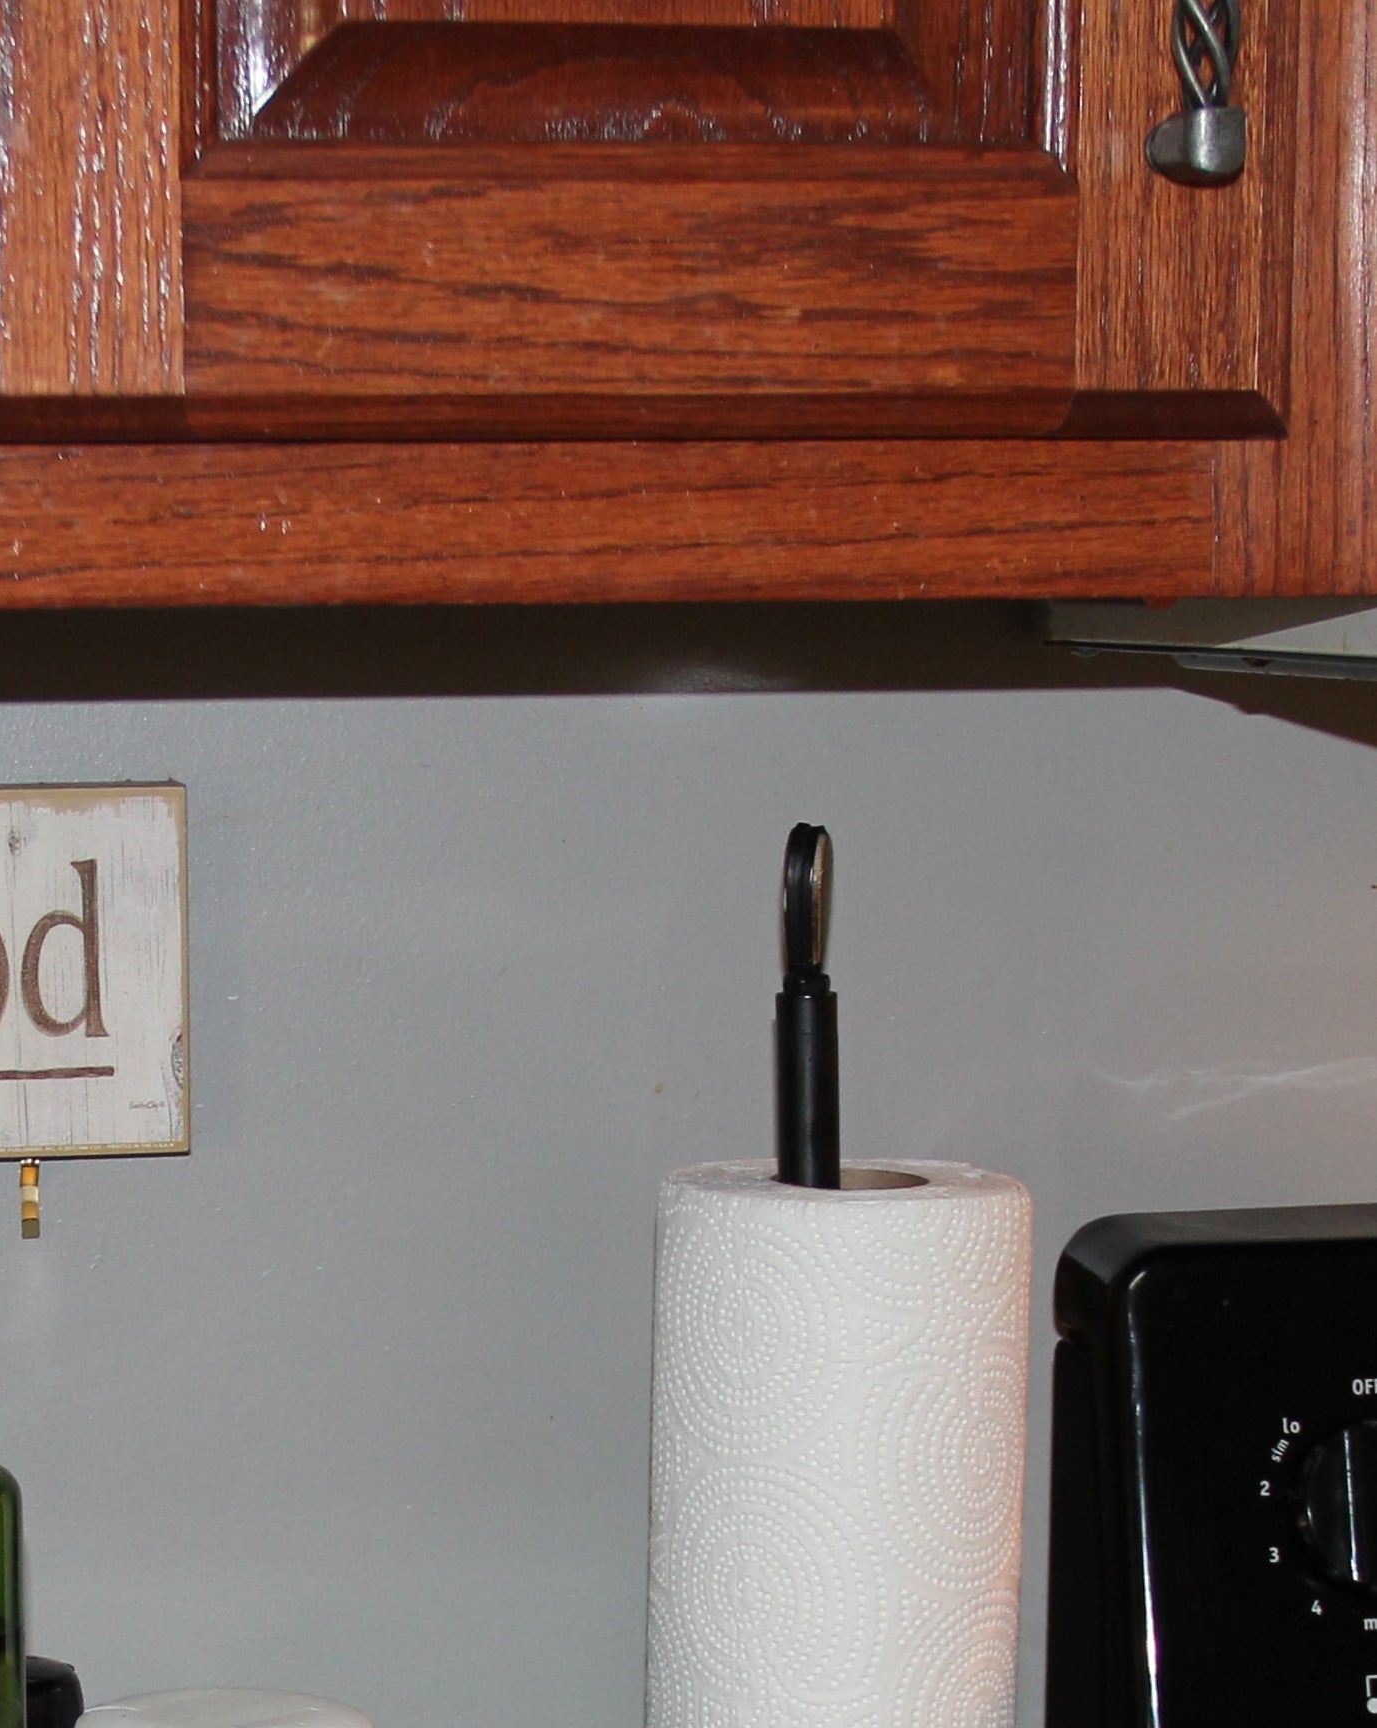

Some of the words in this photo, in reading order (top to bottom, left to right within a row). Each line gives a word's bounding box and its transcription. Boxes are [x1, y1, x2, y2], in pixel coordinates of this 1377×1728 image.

[1283, 1418, 1301, 1434] lo
[1271, 1439, 1290, 1463] sim
[1260, 1480, 1271, 1496] 2
[1269, 1547, 1280, 1563] 3
[1311, 1600, 1322, 1616] 4
